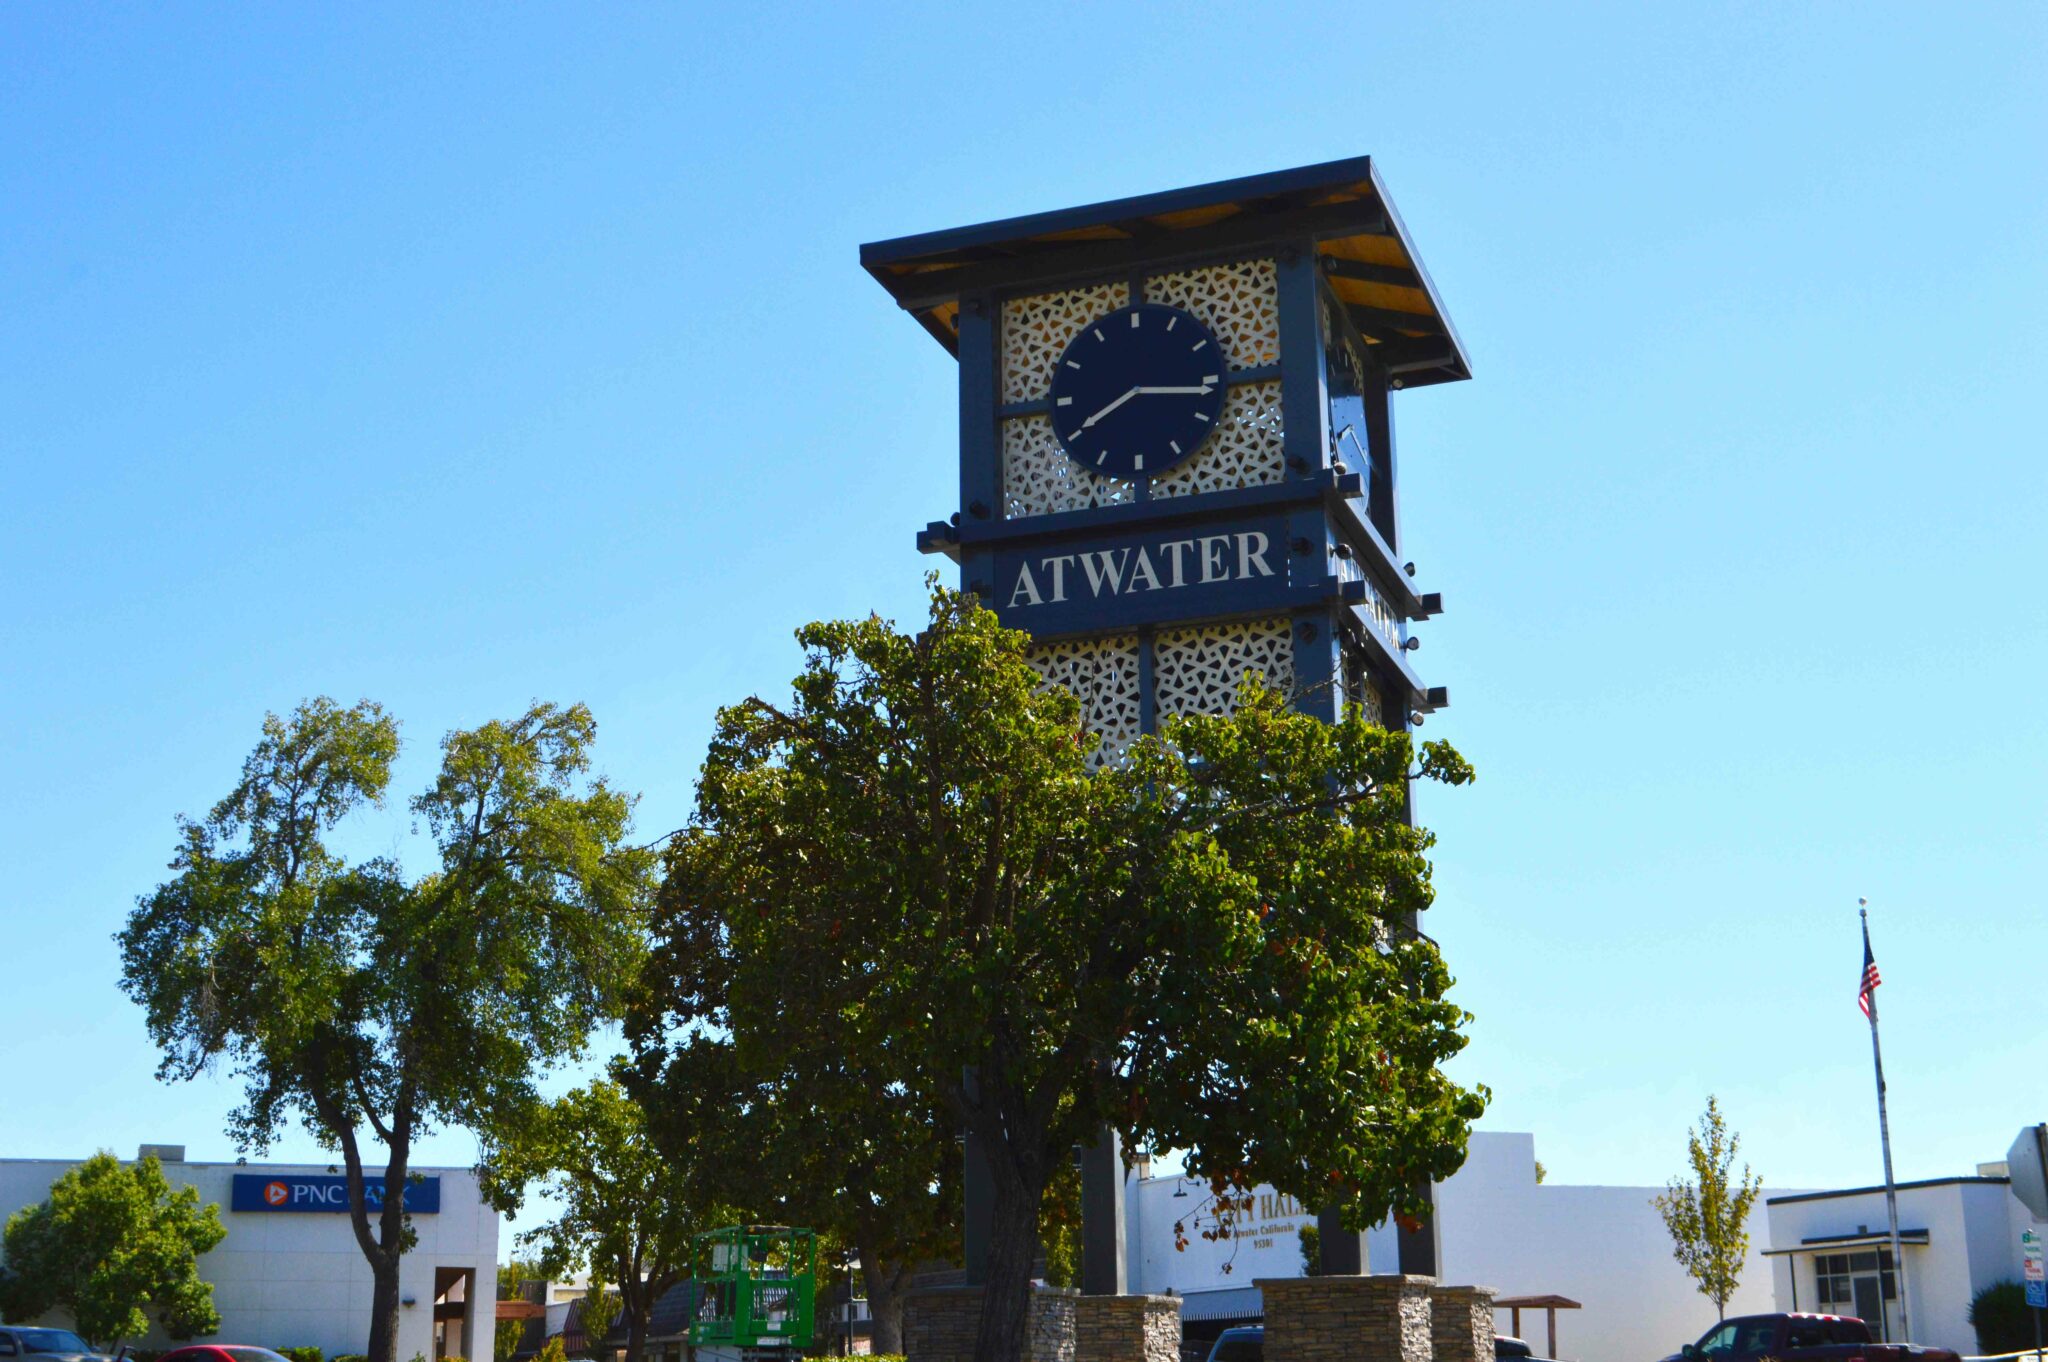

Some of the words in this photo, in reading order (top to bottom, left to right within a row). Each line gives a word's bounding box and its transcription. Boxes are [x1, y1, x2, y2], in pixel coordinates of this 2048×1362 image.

[1007, 531, 1275, 608] ATWATER
[292, 1184, 343, 1203] PNC
[347, 1185, 411, 1204] AN
